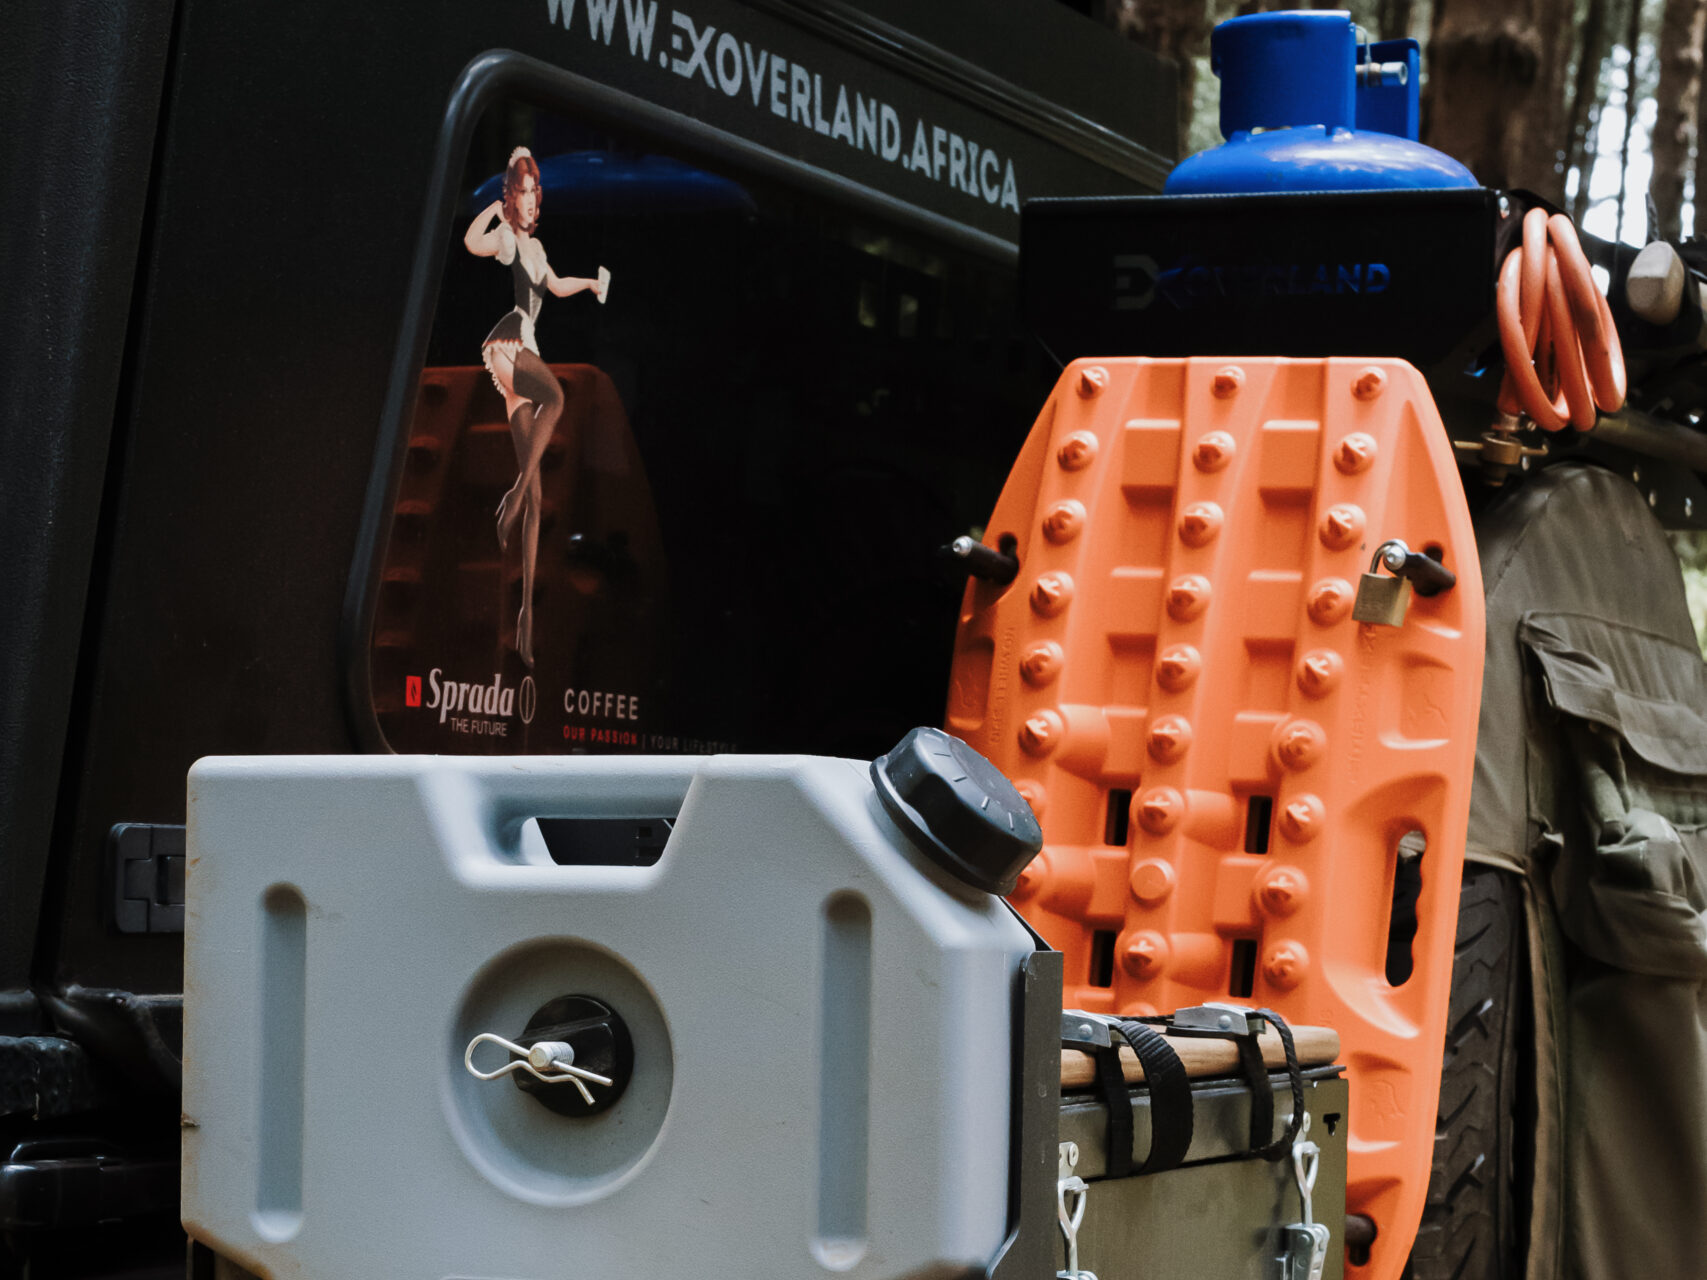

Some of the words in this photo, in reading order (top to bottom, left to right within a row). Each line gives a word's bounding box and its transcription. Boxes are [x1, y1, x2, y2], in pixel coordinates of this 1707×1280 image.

[426, 667, 515, 724] Sprada
[563, 688, 639, 721] COFFEE
[450, 717, 469, 733] THE
[471, 719, 508, 737] FUTURE
[563, 724, 585, 741] OUR
[590, 727, 638, 746] PASSION
